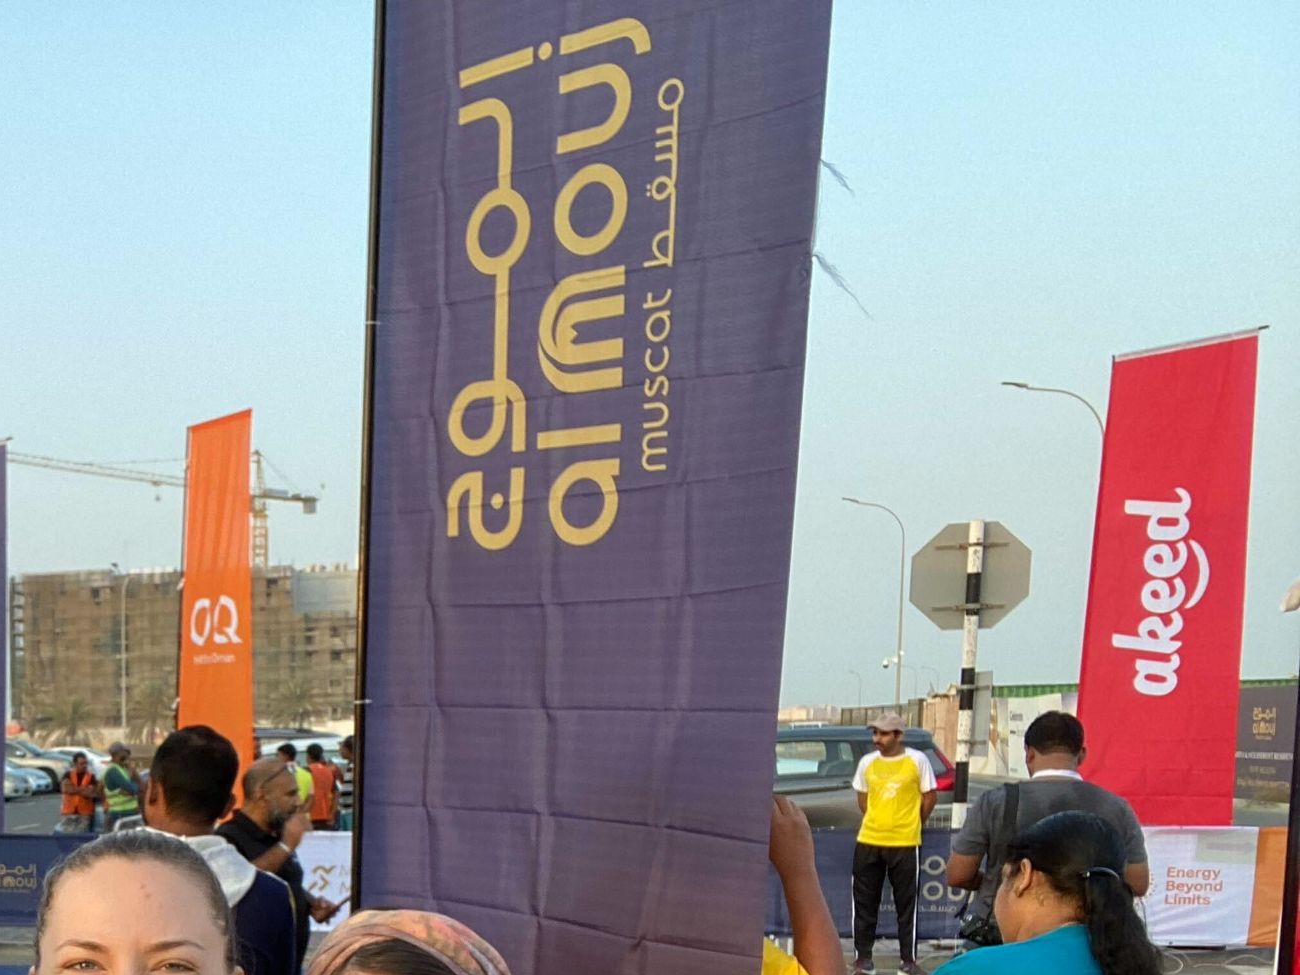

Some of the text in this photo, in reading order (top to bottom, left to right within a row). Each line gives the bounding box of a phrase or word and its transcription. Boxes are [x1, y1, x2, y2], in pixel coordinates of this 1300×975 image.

[644, 78, 685, 267] مسقط
[447, 46, 534, 550] الموج
[641, 288, 672, 472] muscat
[190, 595, 243, 646] OQ
[1111, 487, 1193, 696] akeed
[1164, 894, 1211, 906] Limits
[1165, 880, 1223, 894] Beyond
[1166, 866, 1221, 882] Energy
